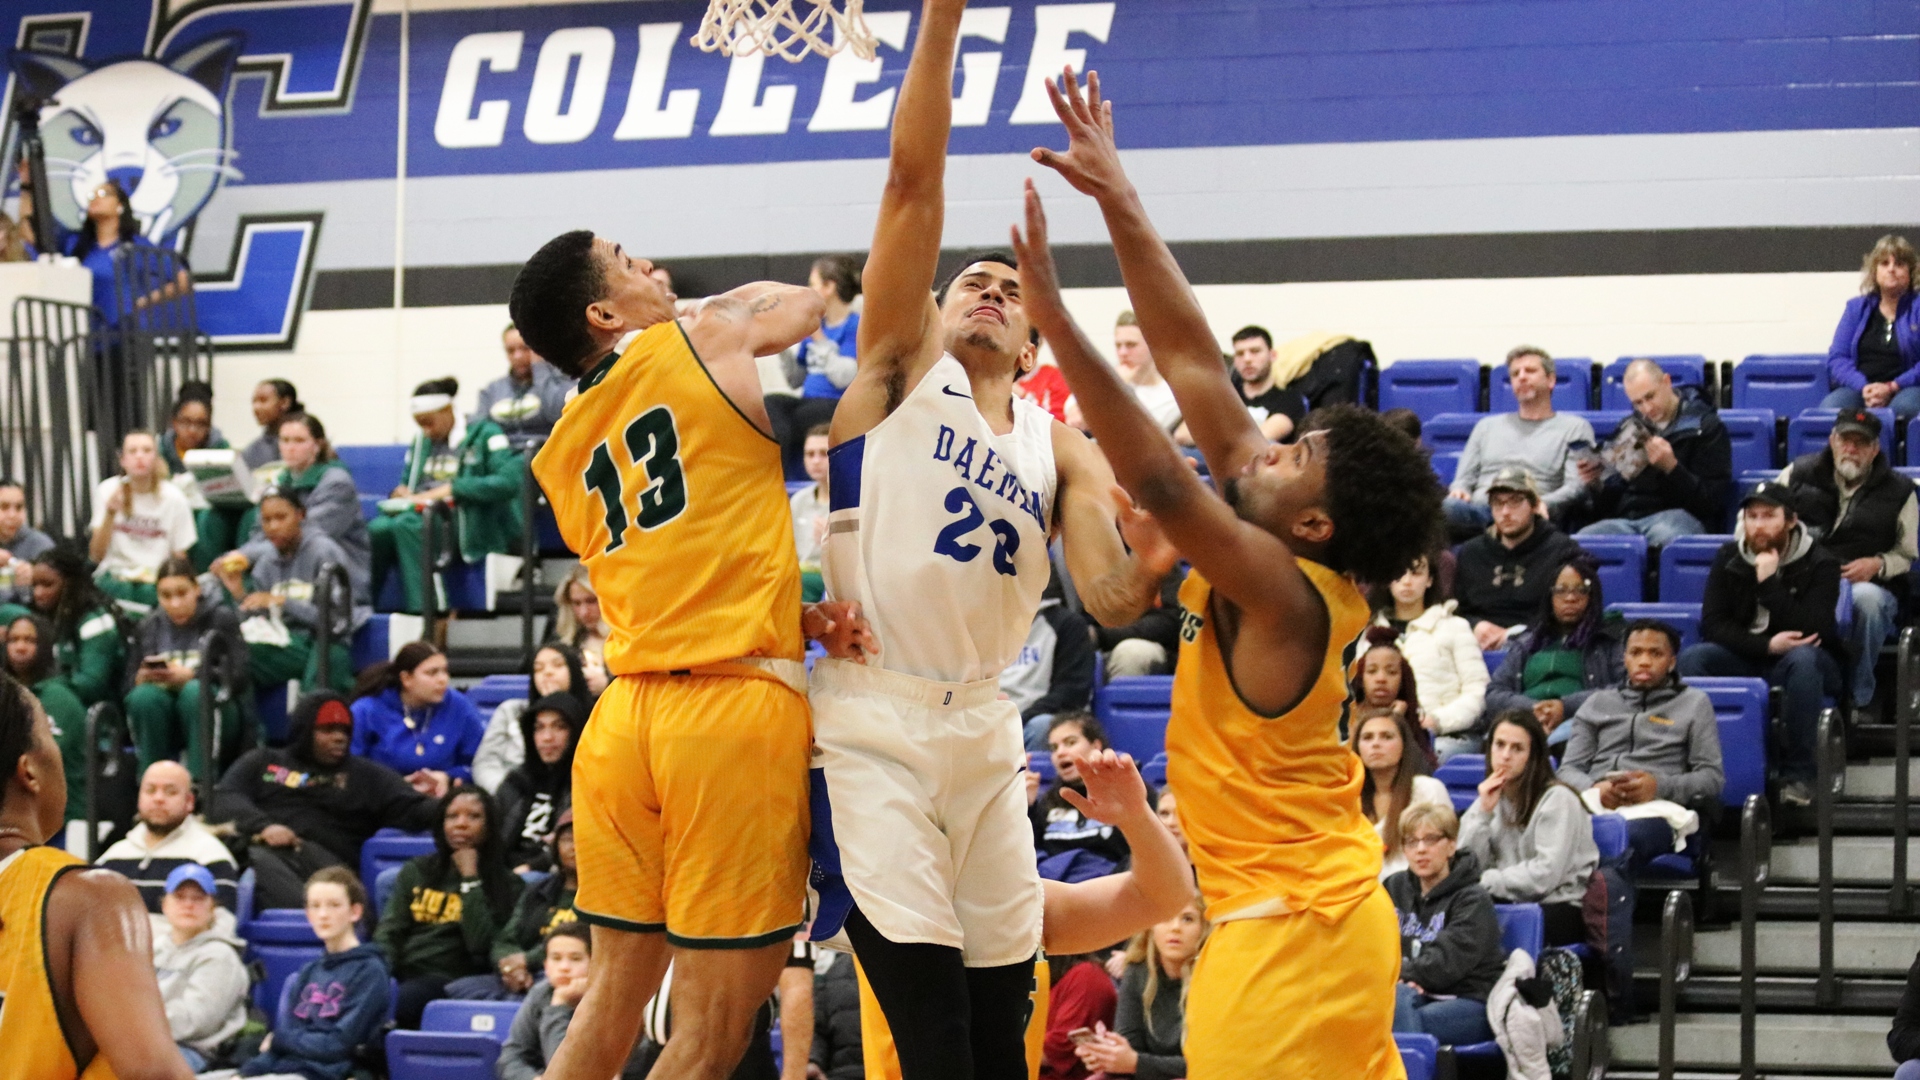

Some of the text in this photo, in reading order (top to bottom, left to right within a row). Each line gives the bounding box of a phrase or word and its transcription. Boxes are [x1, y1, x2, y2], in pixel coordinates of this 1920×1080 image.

[582, 403, 689, 557] 13
[933, 486, 1021, 576] 22
[943, 691, 953, 705] D
